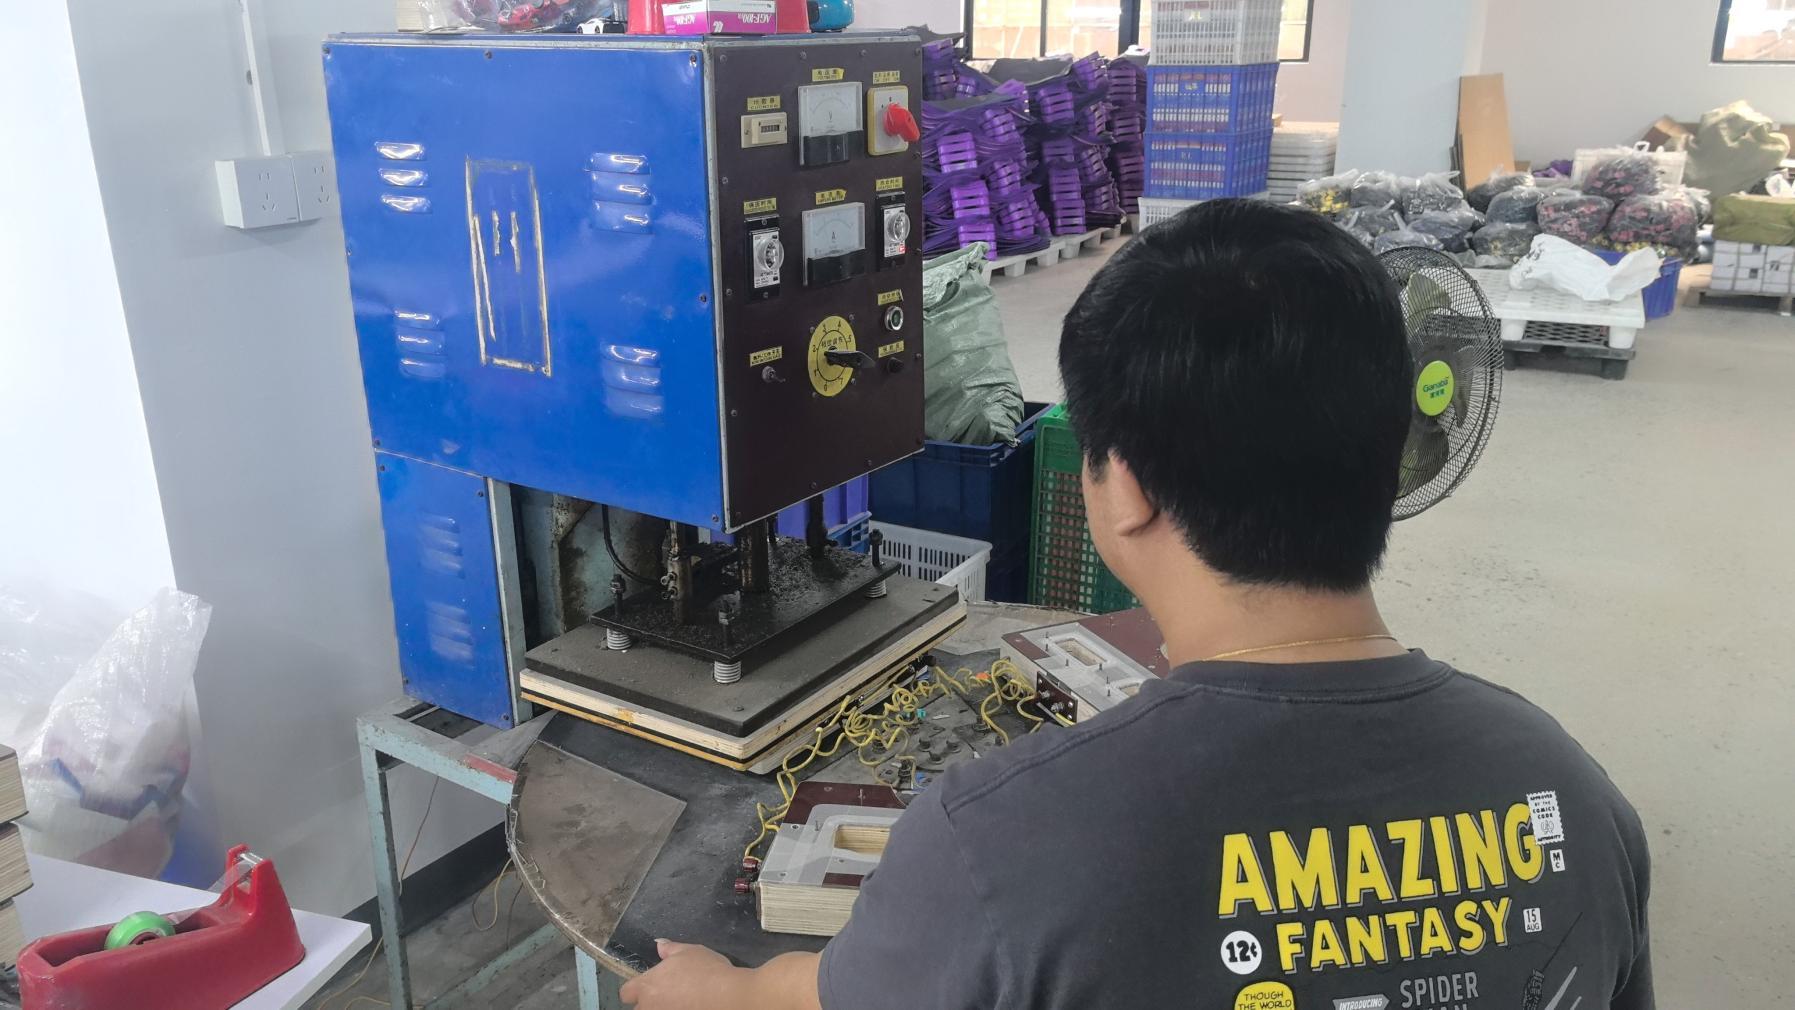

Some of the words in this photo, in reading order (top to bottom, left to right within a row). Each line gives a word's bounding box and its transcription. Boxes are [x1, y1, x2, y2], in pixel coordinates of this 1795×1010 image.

[812, 344, 817, 353] 2
[1218, 802, 1545, 919] AMAZING
[1552, 852, 1561, 862] M
[1526, 909, 1539, 923] 15
[1526, 920, 1540, 933] AUG
[1276, 895, 1513, 975] FANTASY
[1243, 991, 1285, 1001] THOUGH
[1399, 971, 1480, 1009] SPIDER
[1237, 1002, 1257, 1010] THE
[1259, 998, 1293, 1009] WORLD
[1338, 997, 1384, 1010] INTRODUCING
